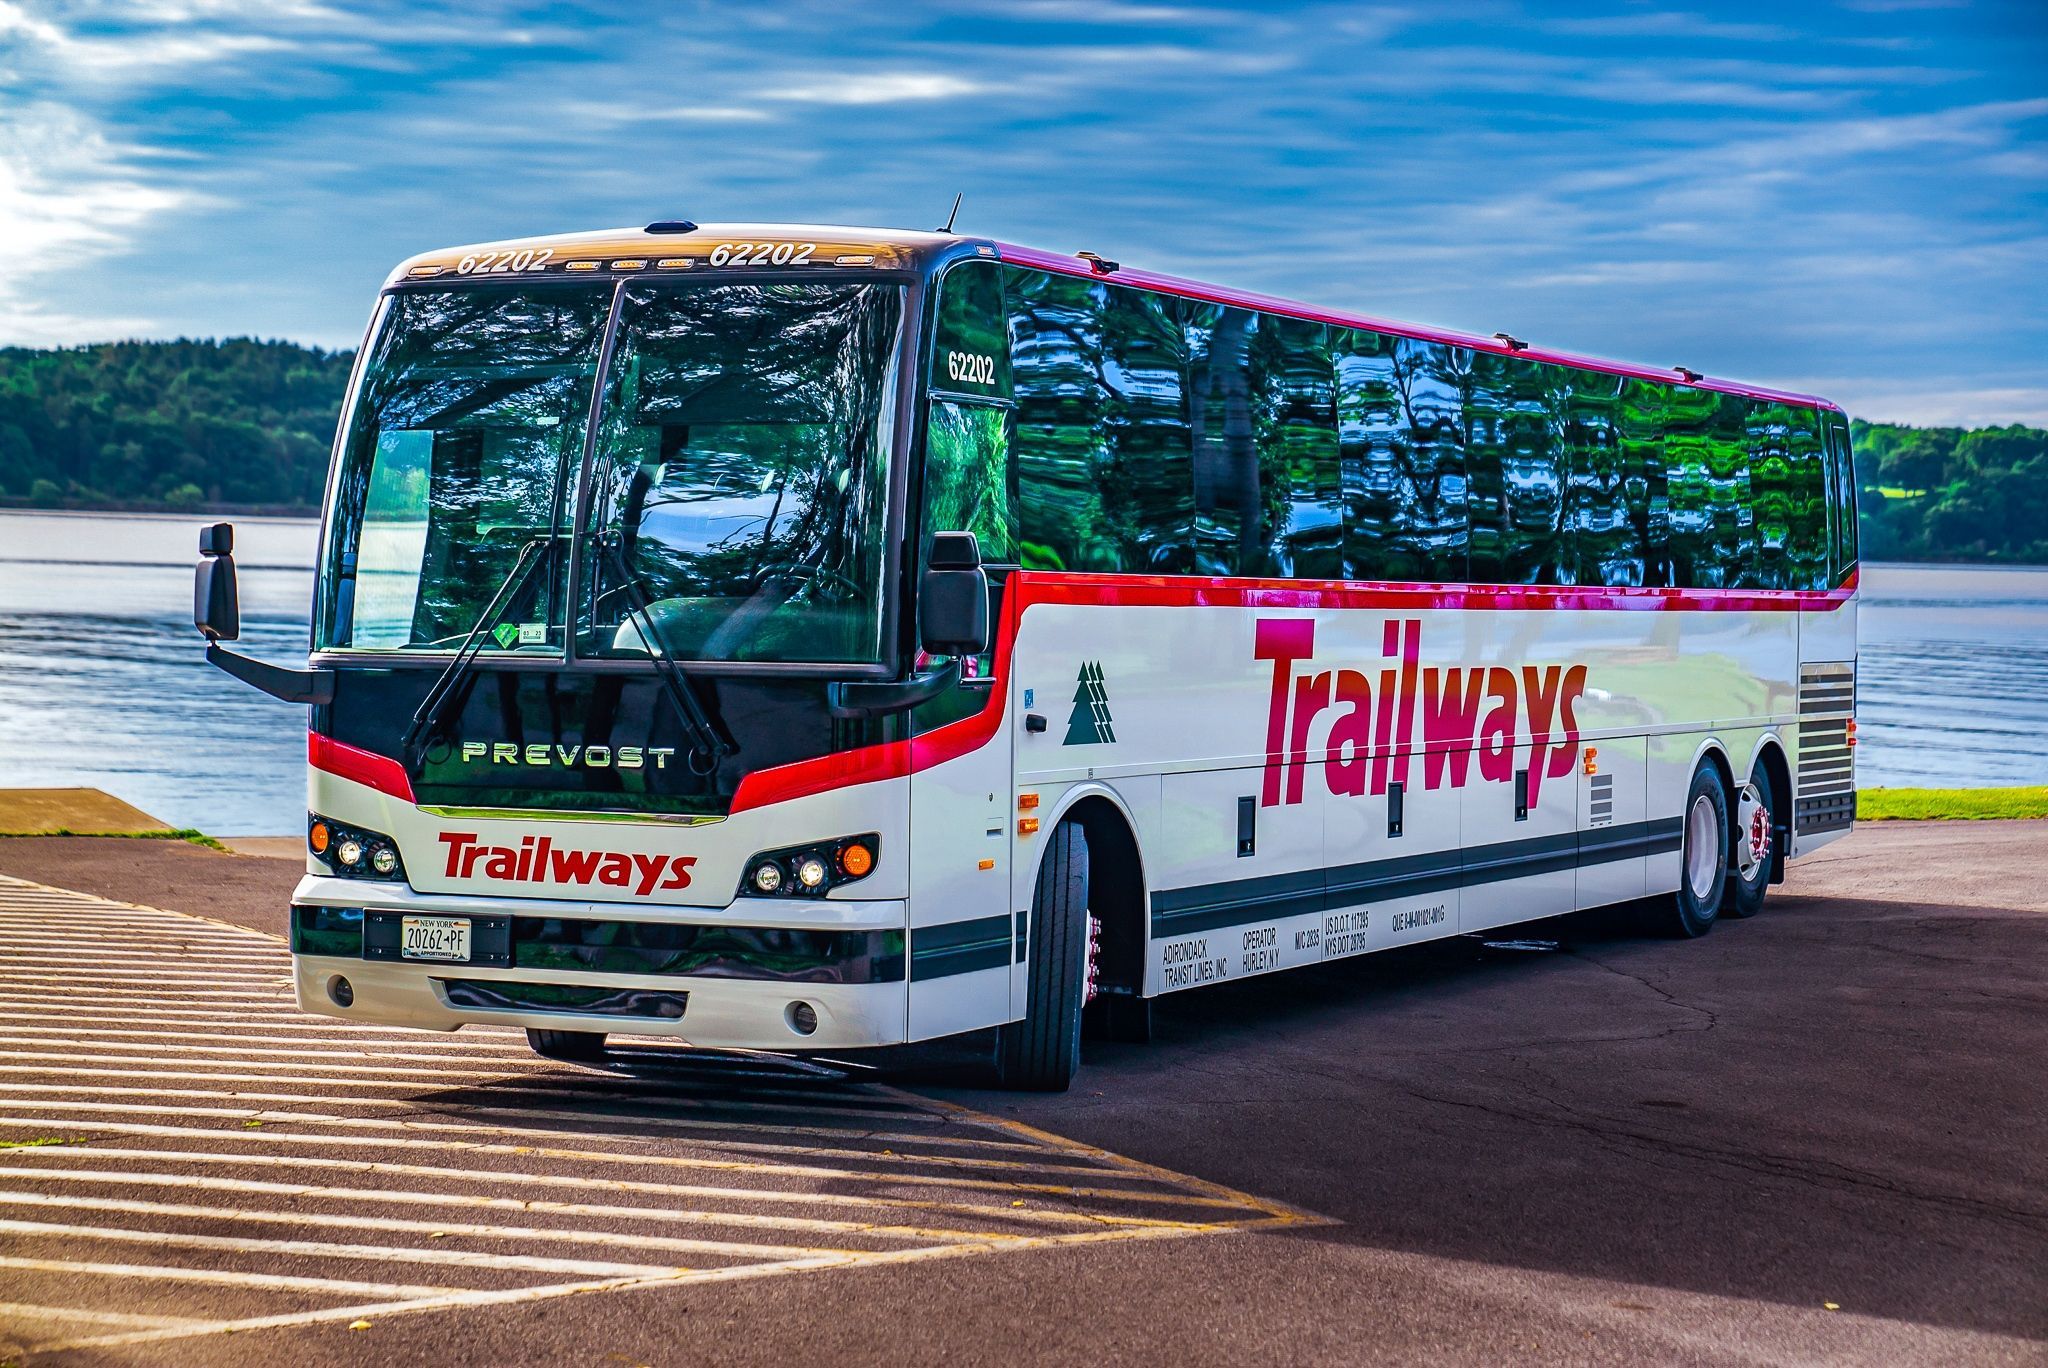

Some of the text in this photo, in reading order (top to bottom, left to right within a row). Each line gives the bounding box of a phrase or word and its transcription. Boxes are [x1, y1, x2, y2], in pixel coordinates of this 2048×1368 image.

[456, 249, 555, 275] 62202
[709, 243, 817, 267] 62202
[948, 350, 996, 385] 62202
[1254, 618, 1588, 809] Trailways
[461, 741, 675, 769] PREVOST
[438, 831, 698, 896] Trailways
[420, 919, 454, 928] NEW YORK
[408, 927, 443, 950] 20262
[1162, 938, 1208, 966] ADIRONDACK
[1242, 927, 1277, 951] OPERATOR
[1325, 936, 1337, 957] NYS
[1337, 934, 1350, 954] DOT
[1164, 957, 1228, 988] TRANSIT LINES, INC
